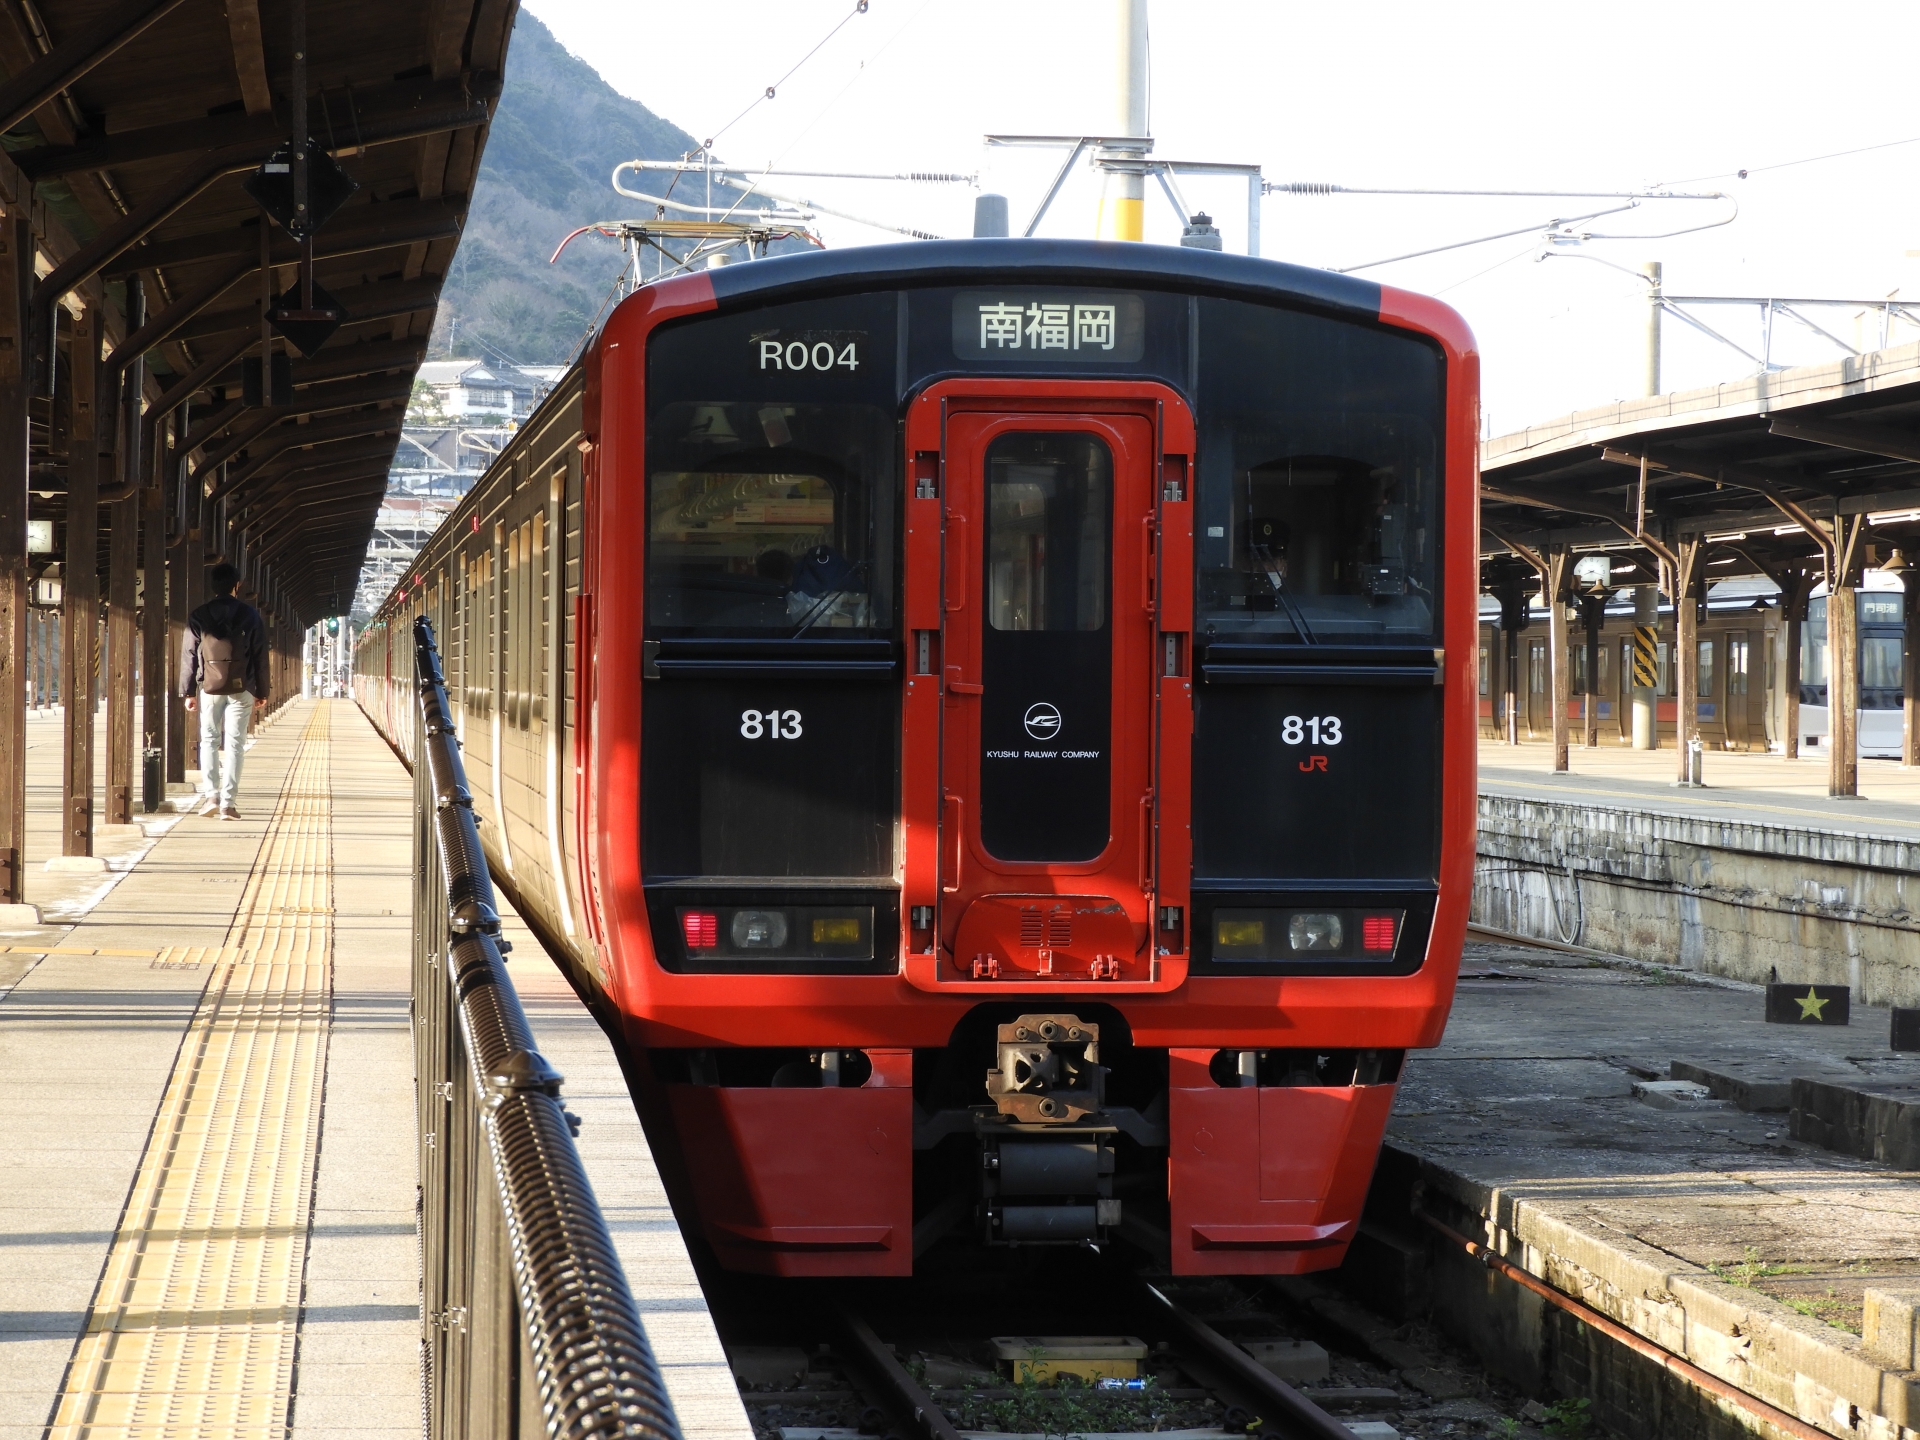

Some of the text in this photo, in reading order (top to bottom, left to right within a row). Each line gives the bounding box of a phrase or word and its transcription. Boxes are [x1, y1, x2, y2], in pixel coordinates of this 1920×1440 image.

[978, 301, 1117, 351] 南福岡
[758, 340, 860, 372] R004
[1864, 602, 1898, 614] 門司港
[739, 709, 804, 740] 813
[1281, 715, 1343, 746] 813
[986, 750, 1100, 759] KYUSHU RAILWAY COMPANY
[1299, 755, 1328, 772] JR
